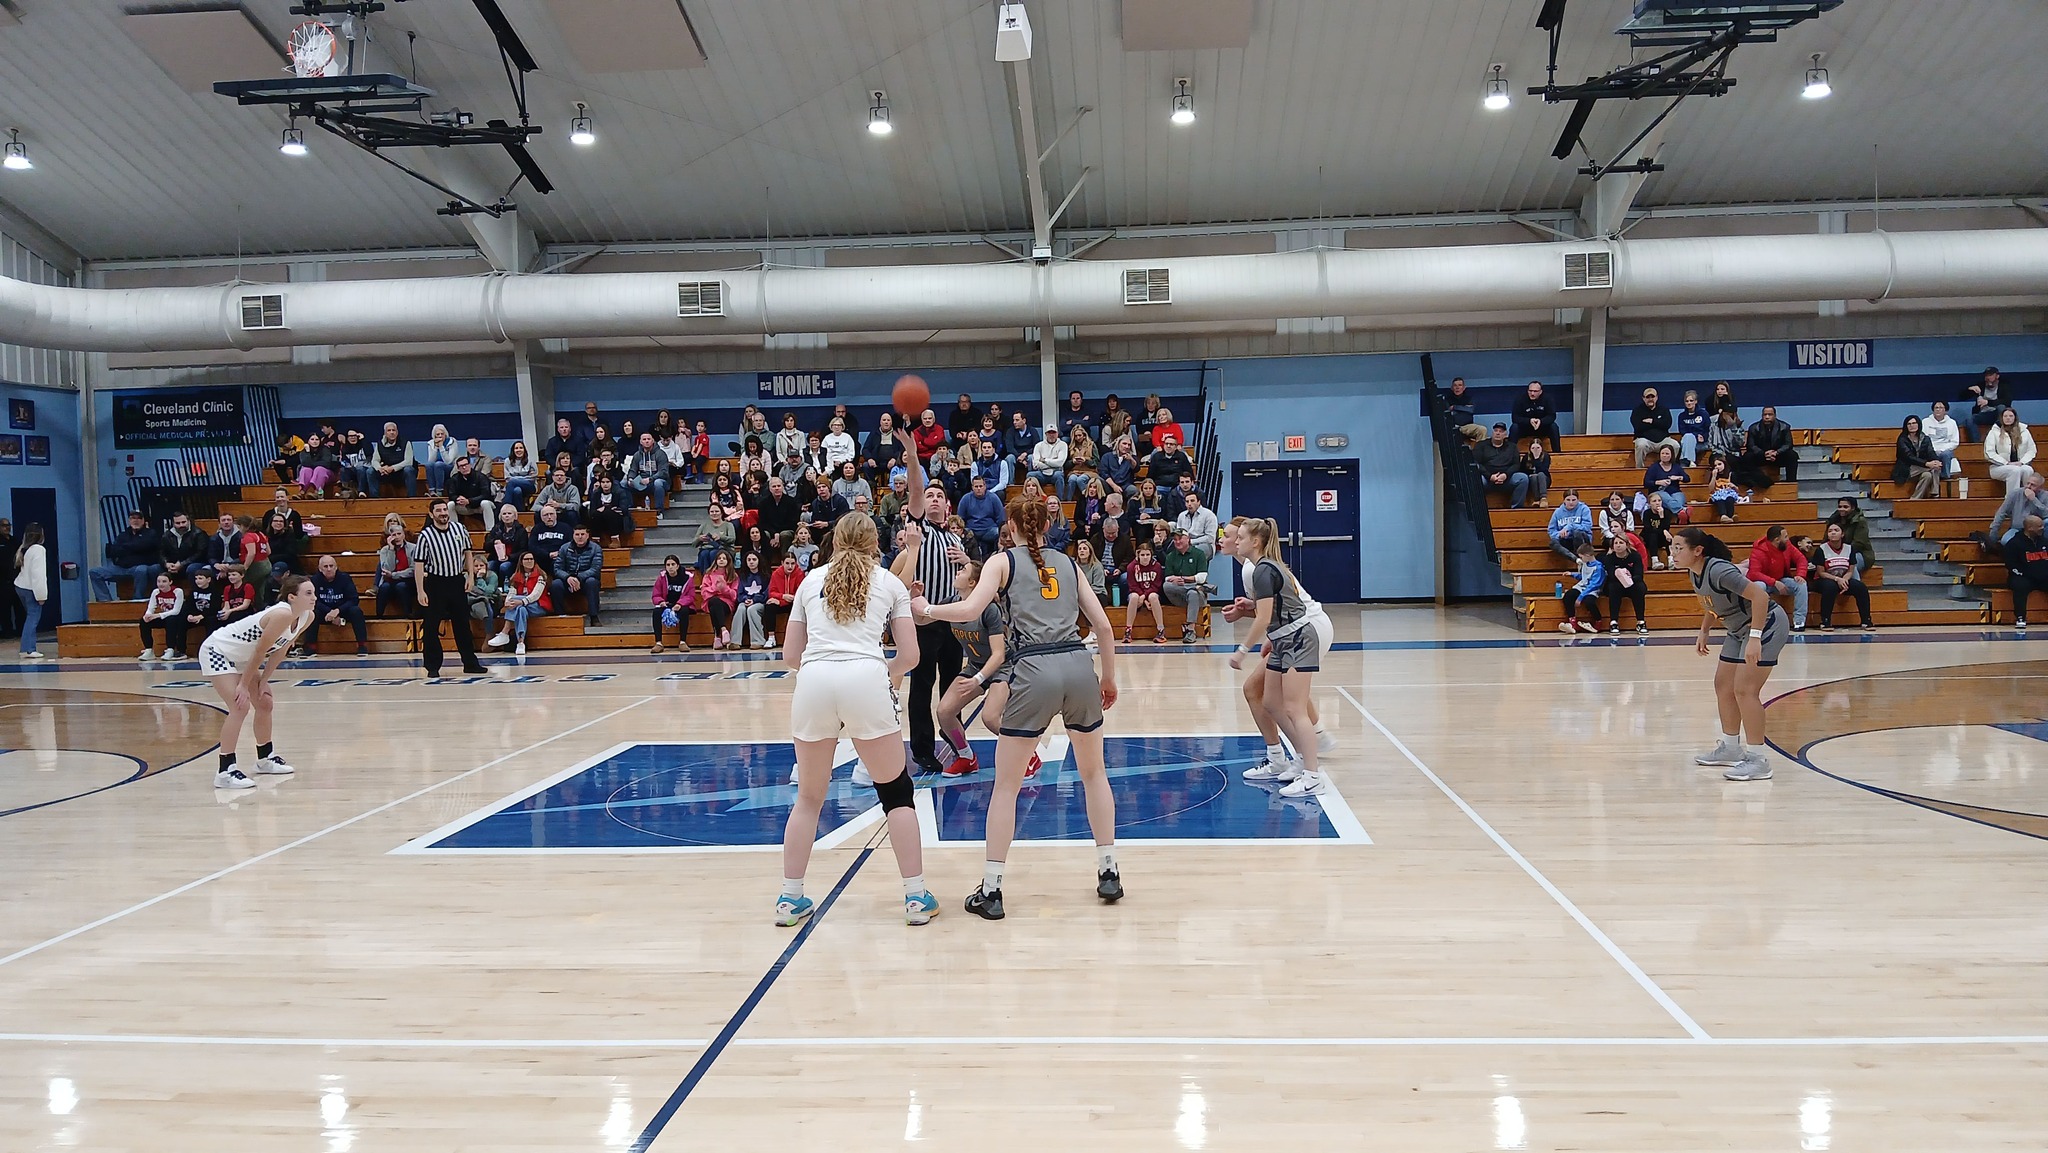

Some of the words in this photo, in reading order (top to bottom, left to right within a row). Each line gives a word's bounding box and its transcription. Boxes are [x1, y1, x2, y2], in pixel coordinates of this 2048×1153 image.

[1796, 343, 1868, 365] VISITOR
[772, 375, 821, 396] HOME
[144, 402, 199, 415] Cleveland
[202, 400, 234, 413] Clinic
[145, 419, 170, 428] Sports
[172, 418, 207, 427] Medicine
[125, 432, 157, 440] OFFICIAL
[159, 431, 193, 439] MEDICAL
[1288, 437, 1303, 449] EXIT
[1037, 566, 1060, 600] 5
